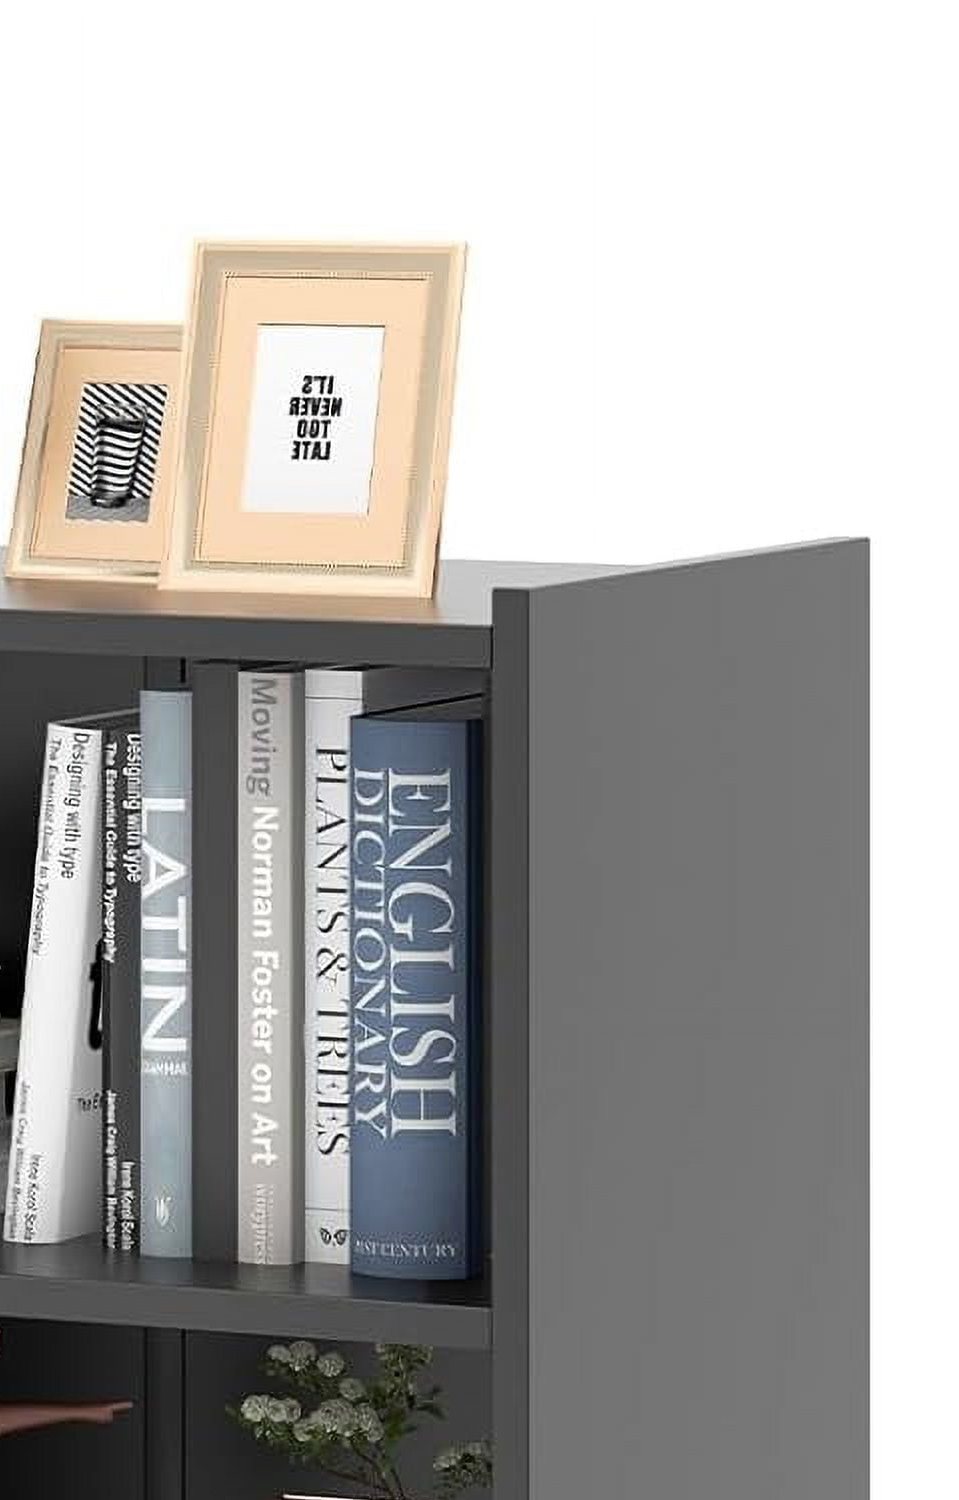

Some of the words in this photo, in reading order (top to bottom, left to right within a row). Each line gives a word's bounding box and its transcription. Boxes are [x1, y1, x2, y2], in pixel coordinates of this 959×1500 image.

[63, 732, 90, 808] Designing
[105, 742, 118, 766] The
[246, 679, 277, 797] Moving
[64, 810, 82, 843] with
[105, 769, 118, 829] Essential
[59, 847, 81, 880] type
[123, 848, 141, 884] type
[251, 806, 279, 938] Norman
[316, 748, 349, 934] PLANTS
[105, 872, 118, 886] to
[141, 797, 187, 1050] LATIN
[354, 767, 387, 1139] DICTIONARY
[388, 766, 456, 1137] ENGLISH
[317, 947, 348, 986] &
[252, 951, 279, 1054] Foster
[252, 1063, 272, 1102] on
[316, 999, 349, 1155] TREES
[252, 1112, 279, 1166] Art
